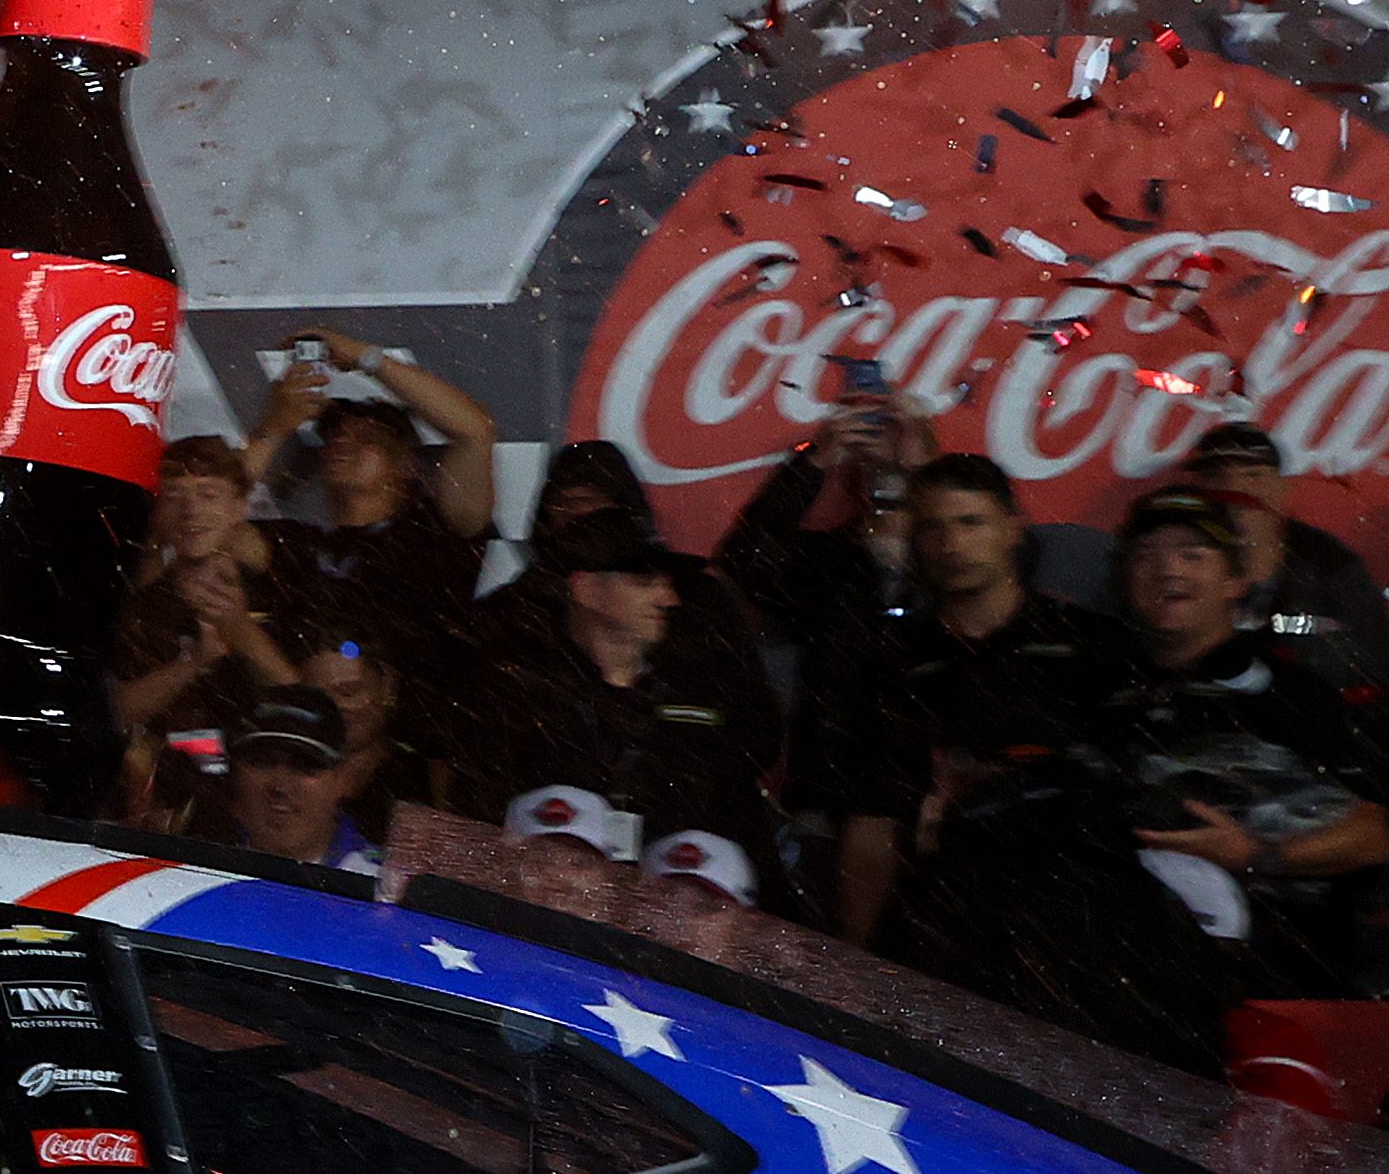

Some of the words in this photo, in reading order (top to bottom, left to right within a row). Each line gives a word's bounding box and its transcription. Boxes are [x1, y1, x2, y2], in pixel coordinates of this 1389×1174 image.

[8, 987, 94, 1013] TWG
[11, 1021, 104, 1030] MOTORSPORTS
[18, 1062, 123, 1098] Garner
[39, 1132, 137, 1164] Coca-Cola
